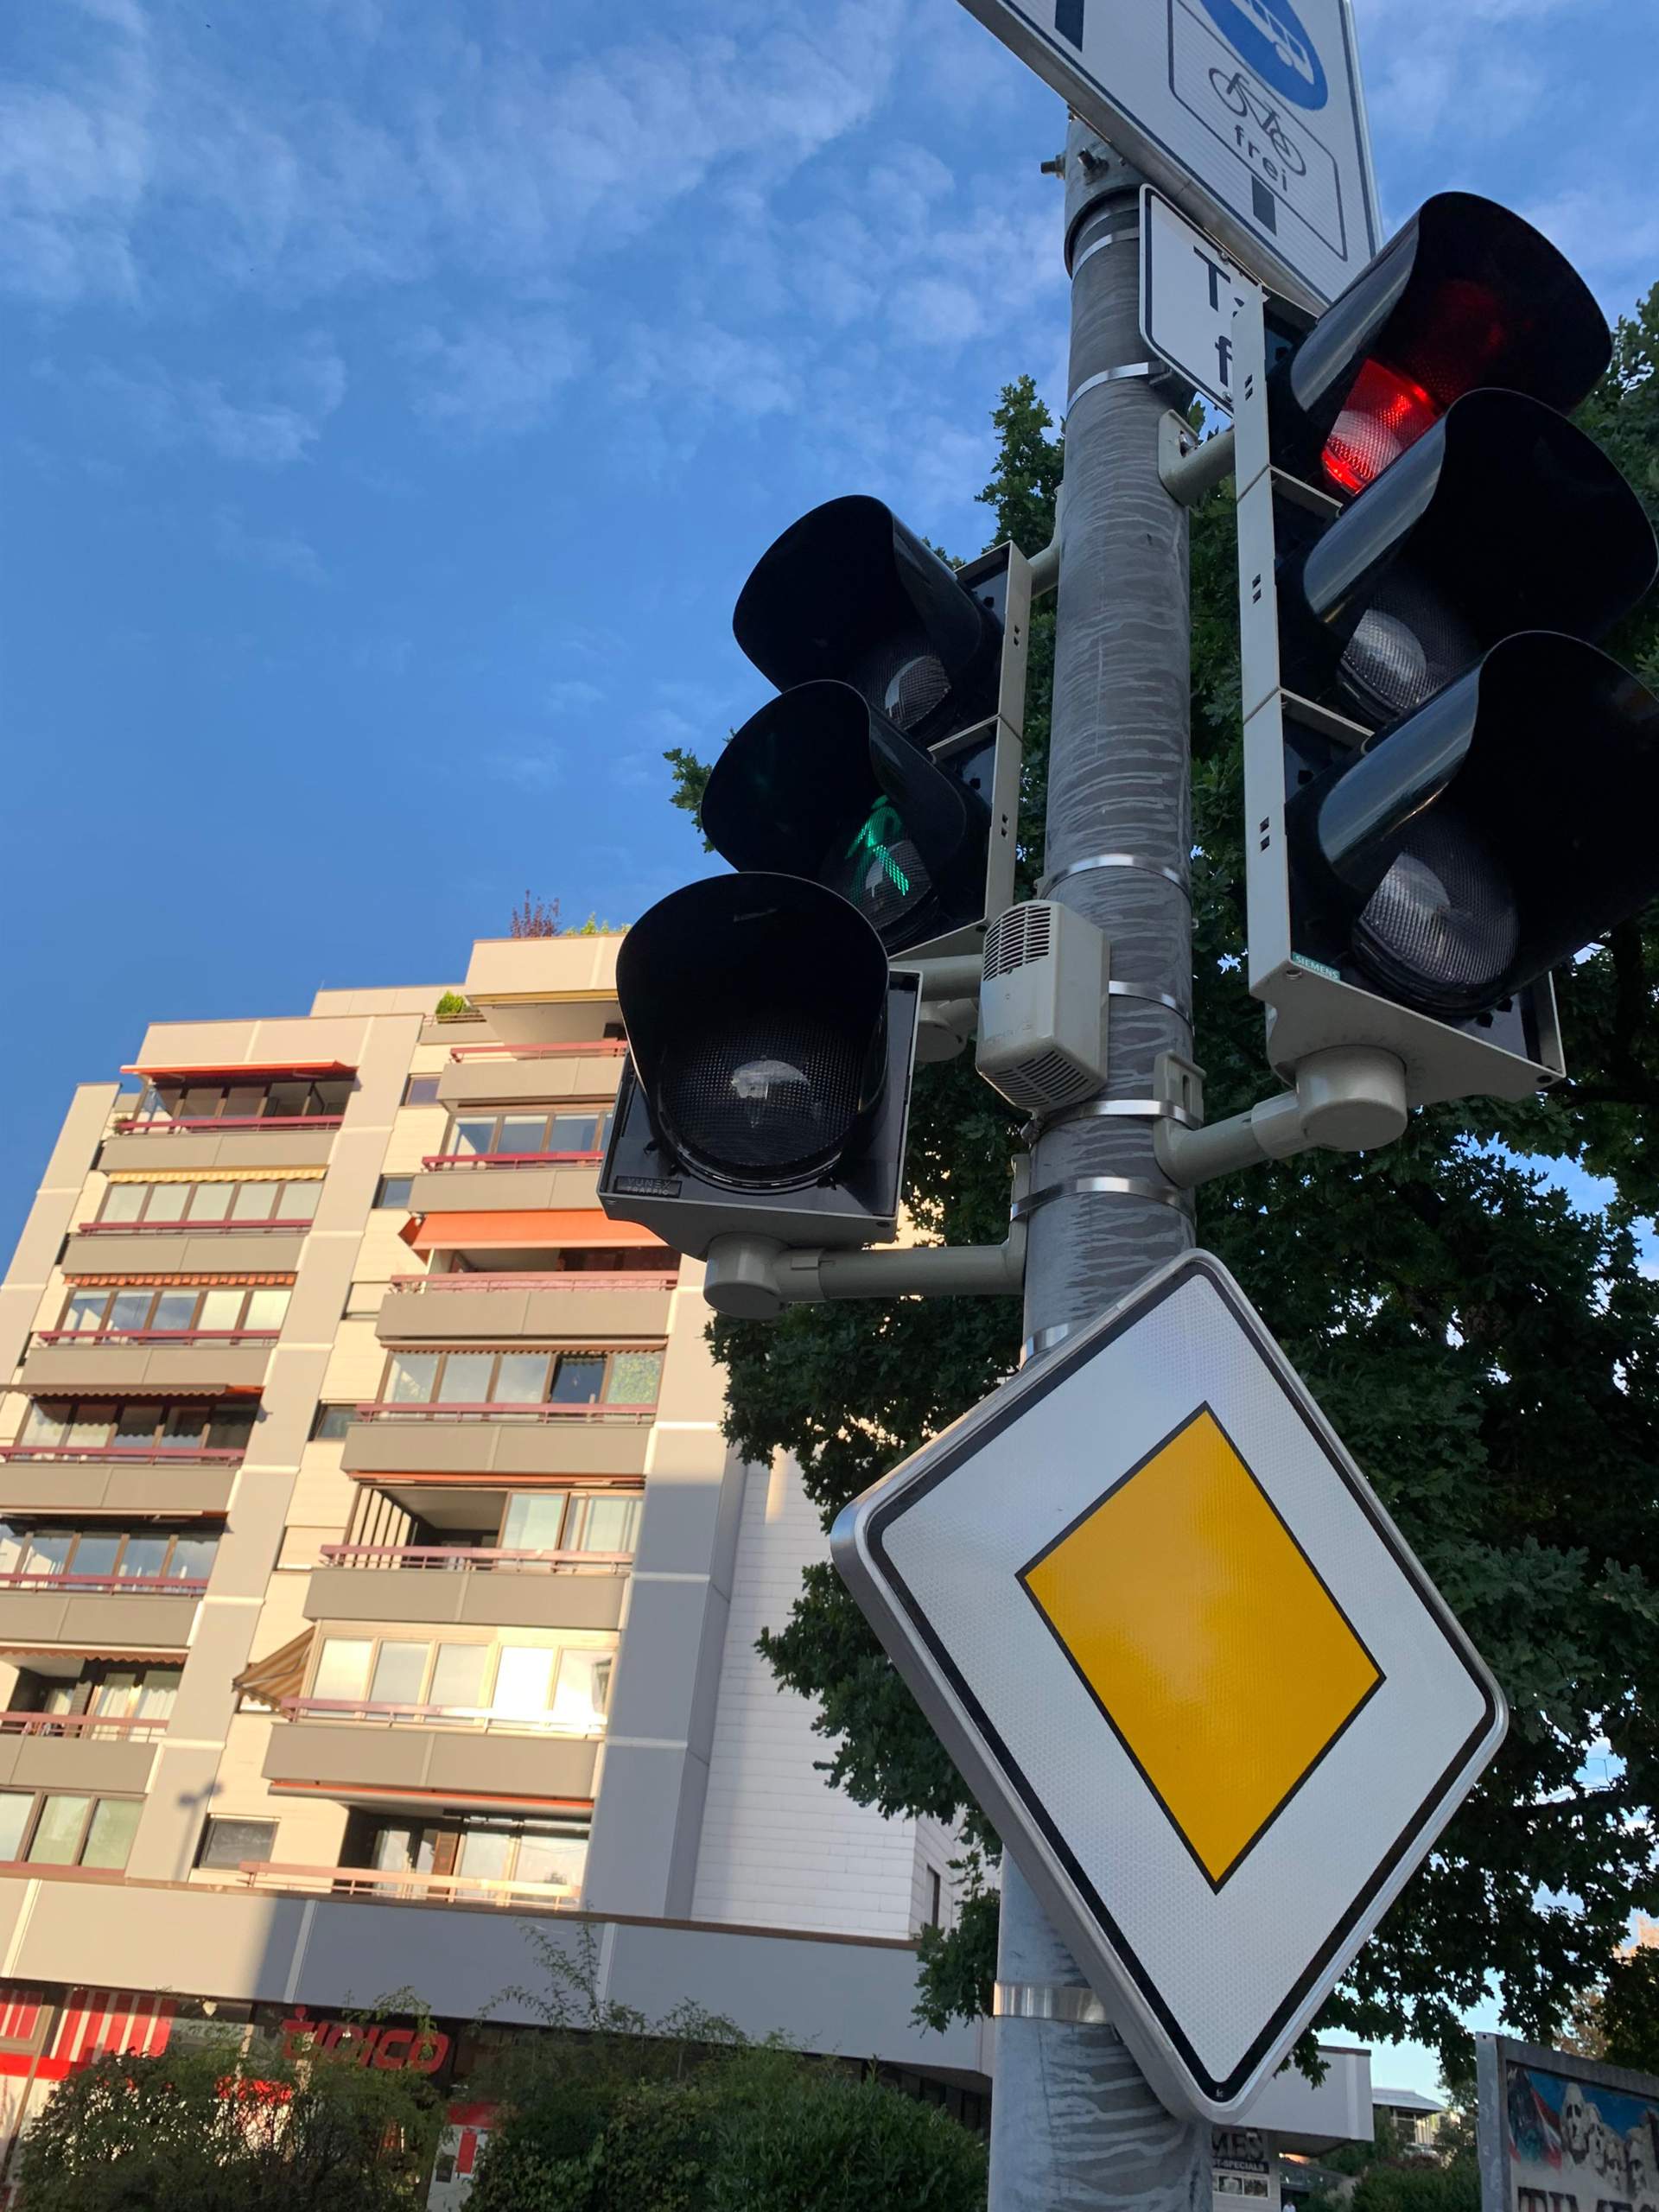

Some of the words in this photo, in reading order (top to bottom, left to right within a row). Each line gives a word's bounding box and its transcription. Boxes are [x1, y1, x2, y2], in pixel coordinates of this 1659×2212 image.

[1234, 124, 1287, 192] frei
[1295, 955, 1338, 979] SIEMENS
[626, 1186, 670, 1196] TRAFFIC
[628, 1178, 671, 1189] YUNEX
